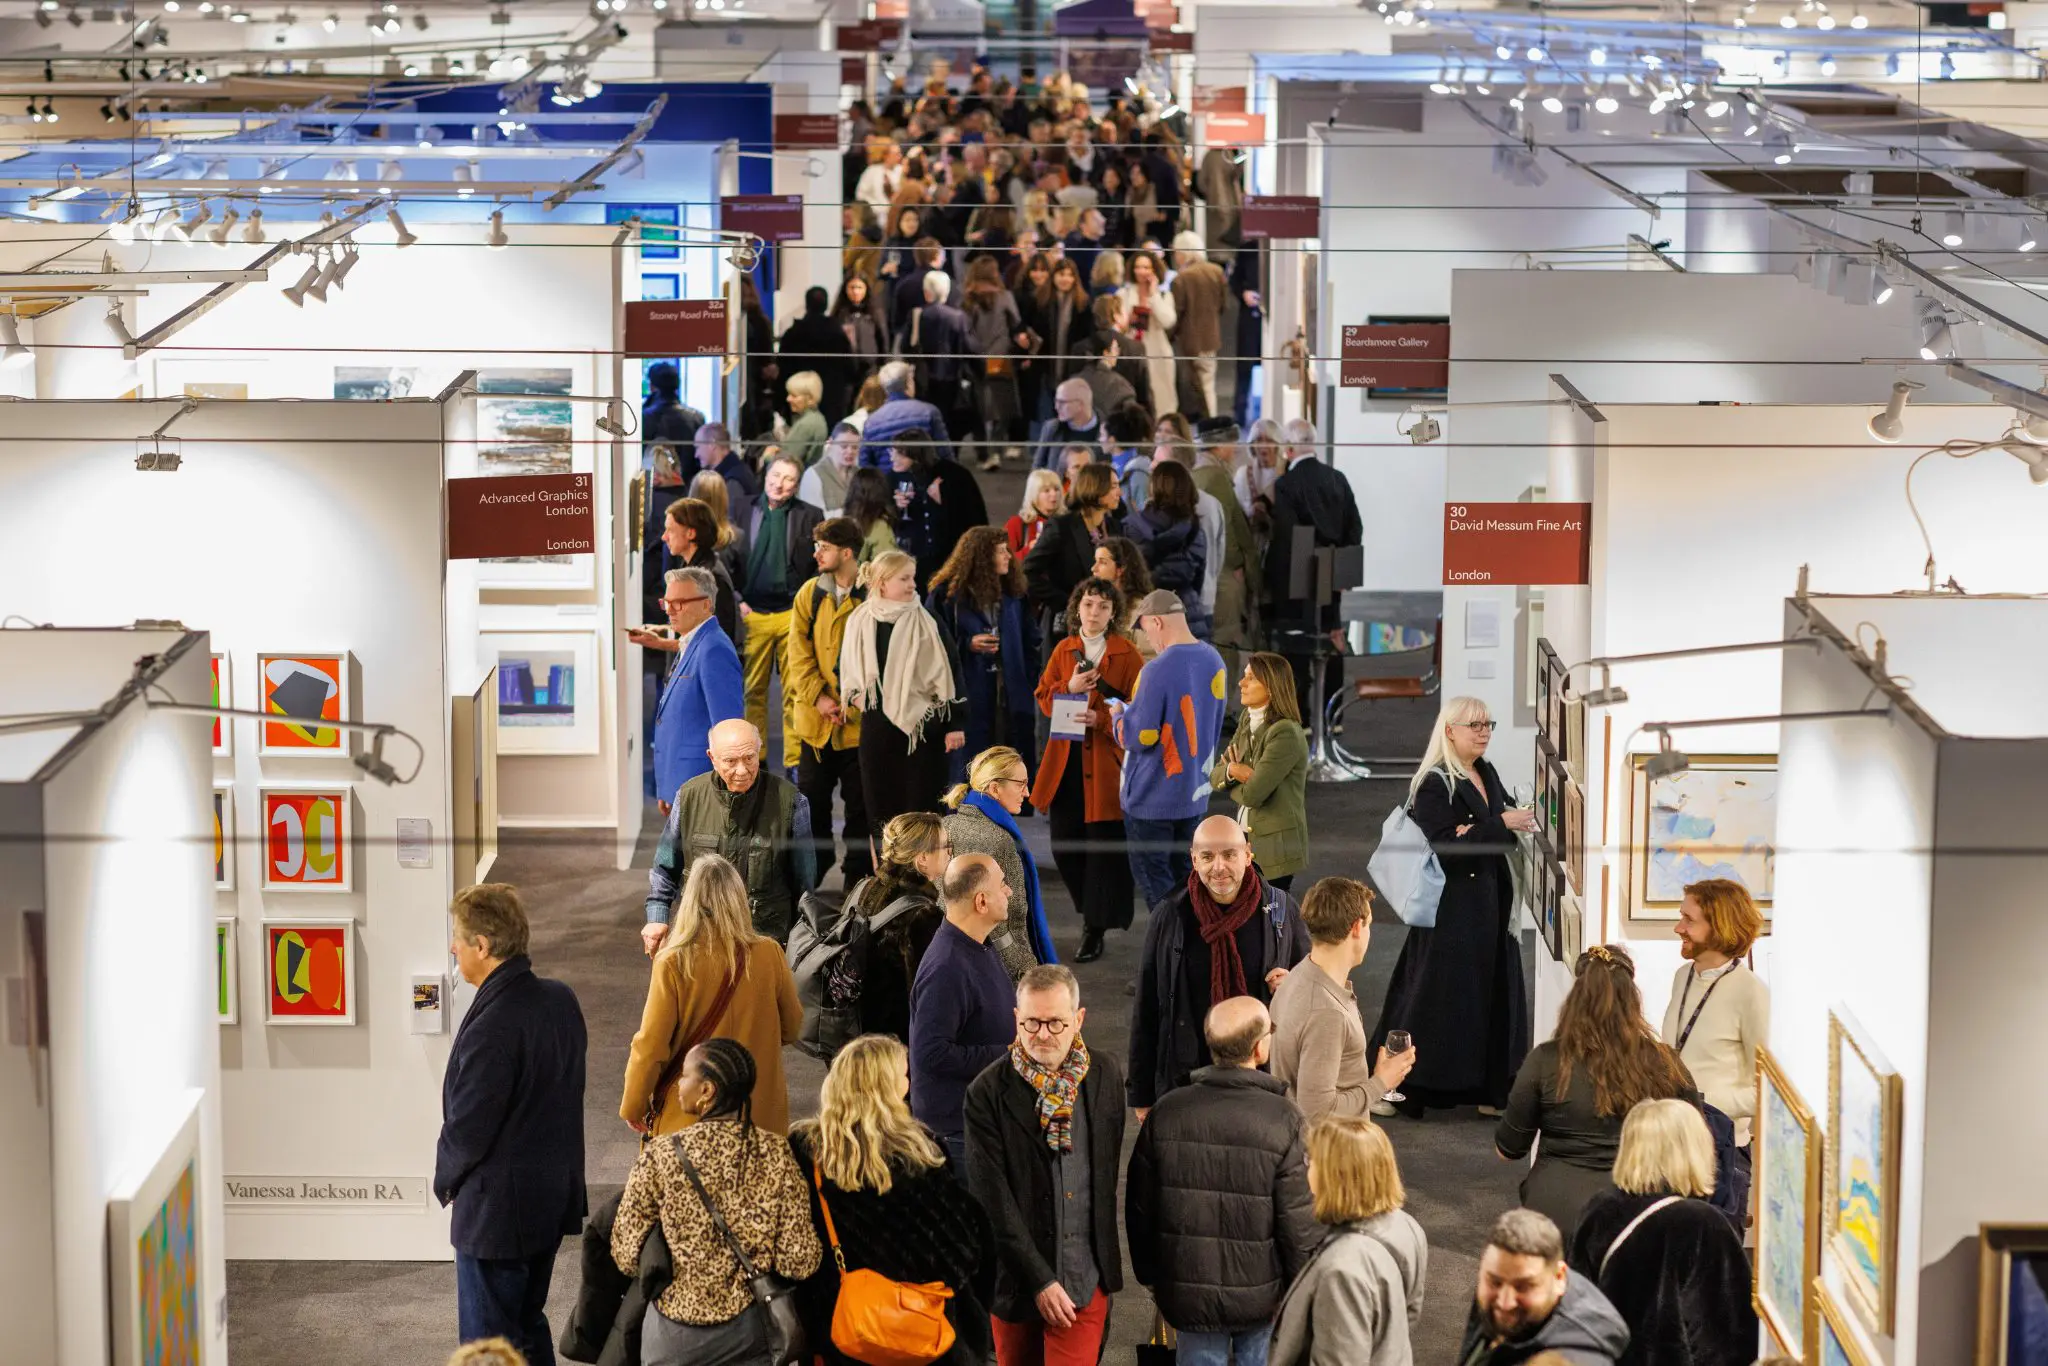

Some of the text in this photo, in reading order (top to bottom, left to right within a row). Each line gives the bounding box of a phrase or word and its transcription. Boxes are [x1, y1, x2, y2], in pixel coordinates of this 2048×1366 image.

[649, 310, 724, 321] Stoney Road Press
[1345, 327, 1358, 336] 29
[1345, 337, 1429, 348] Beardsmore Gallery
[1344, 375, 1377, 384] London
[575, 476, 588, 487] 31
[479, 489, 589, 504] Advanced Graphics
[546, 504, 589, 516] London
[1450, 506, 1467, 517] 30
[1450, 519, 1582, 531] David Messum Fine Art
[547, 538, 590, 550] London
[1448, 569, 1491, 580] London
[225, 1182, 404, 1200] Vanessa Jackson RA
